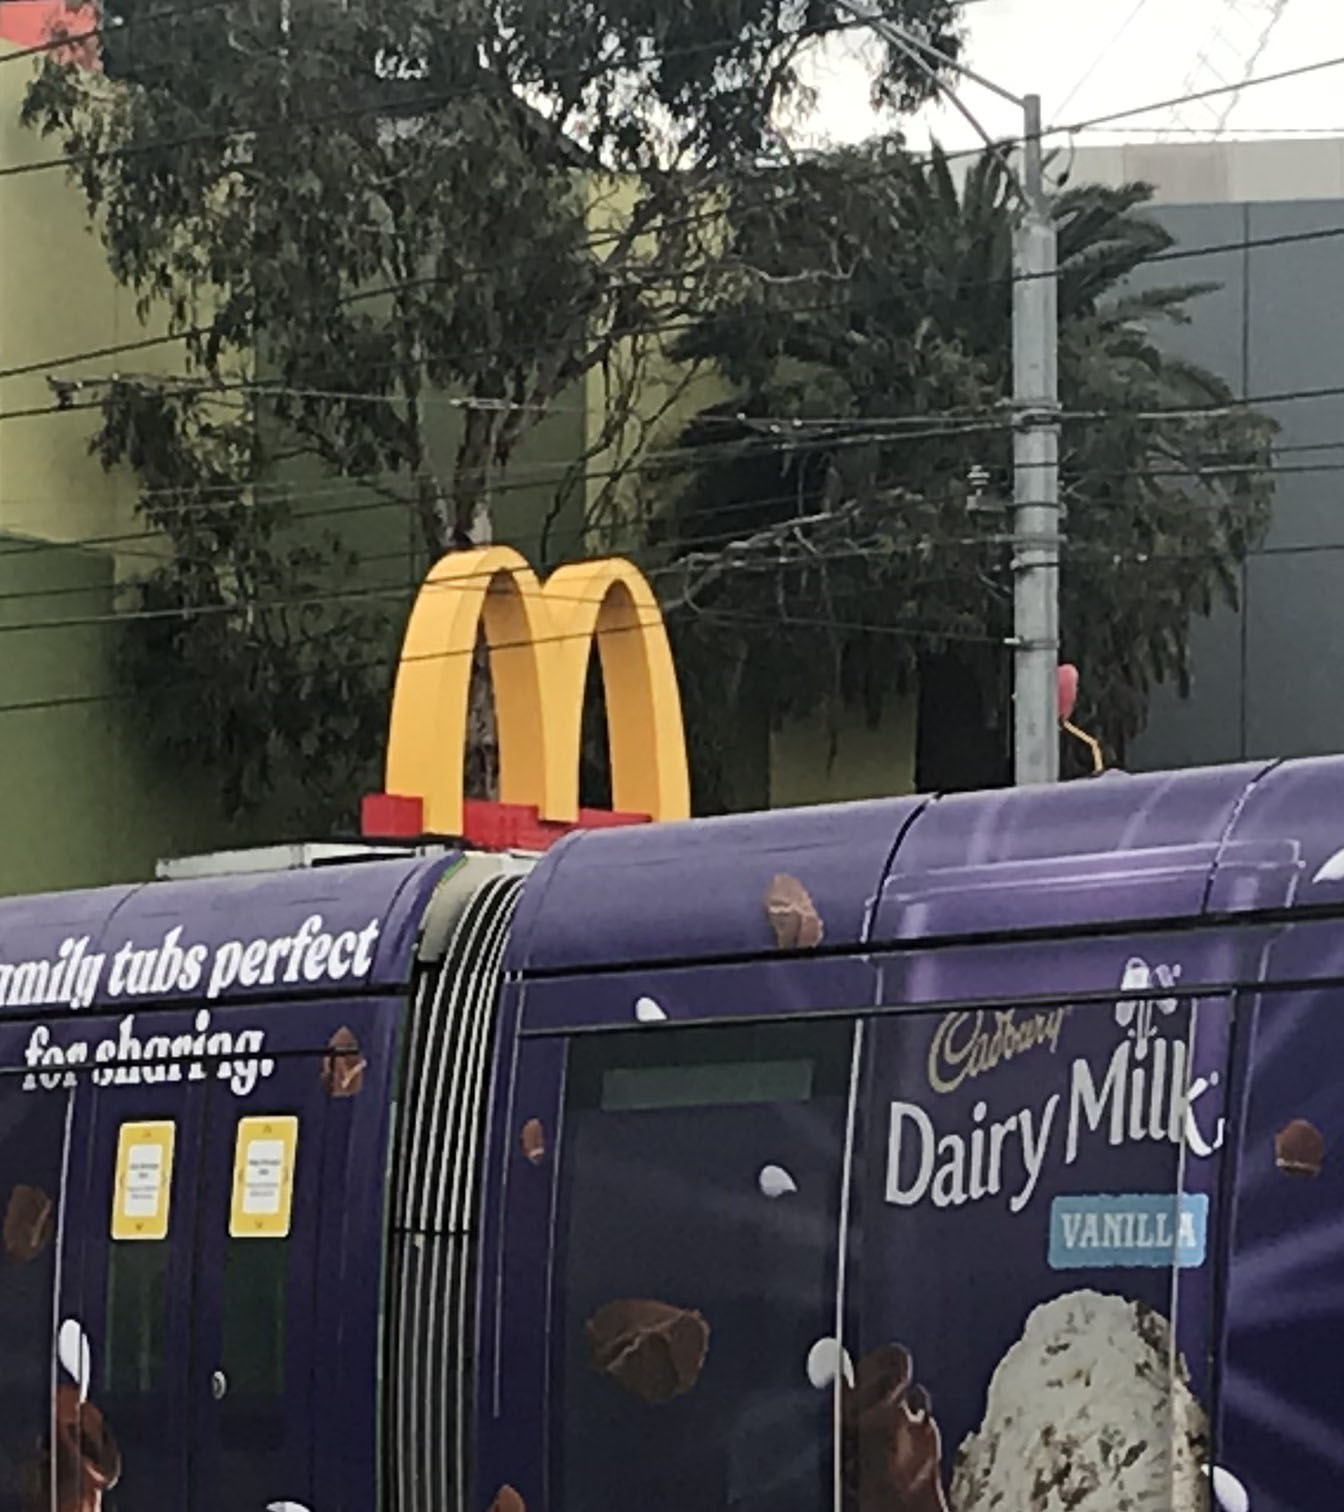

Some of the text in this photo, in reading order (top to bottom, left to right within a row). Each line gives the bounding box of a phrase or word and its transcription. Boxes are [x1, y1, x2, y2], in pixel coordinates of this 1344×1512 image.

[108, 924, 206, 997] tubs
[206, 914, 379, 999] perfect
[22, 1025, 88, 1092] for
[885, 1036, 1226, 1214] Dairy Milk
[1060, 1212, 1198, 1249] VANILLA
